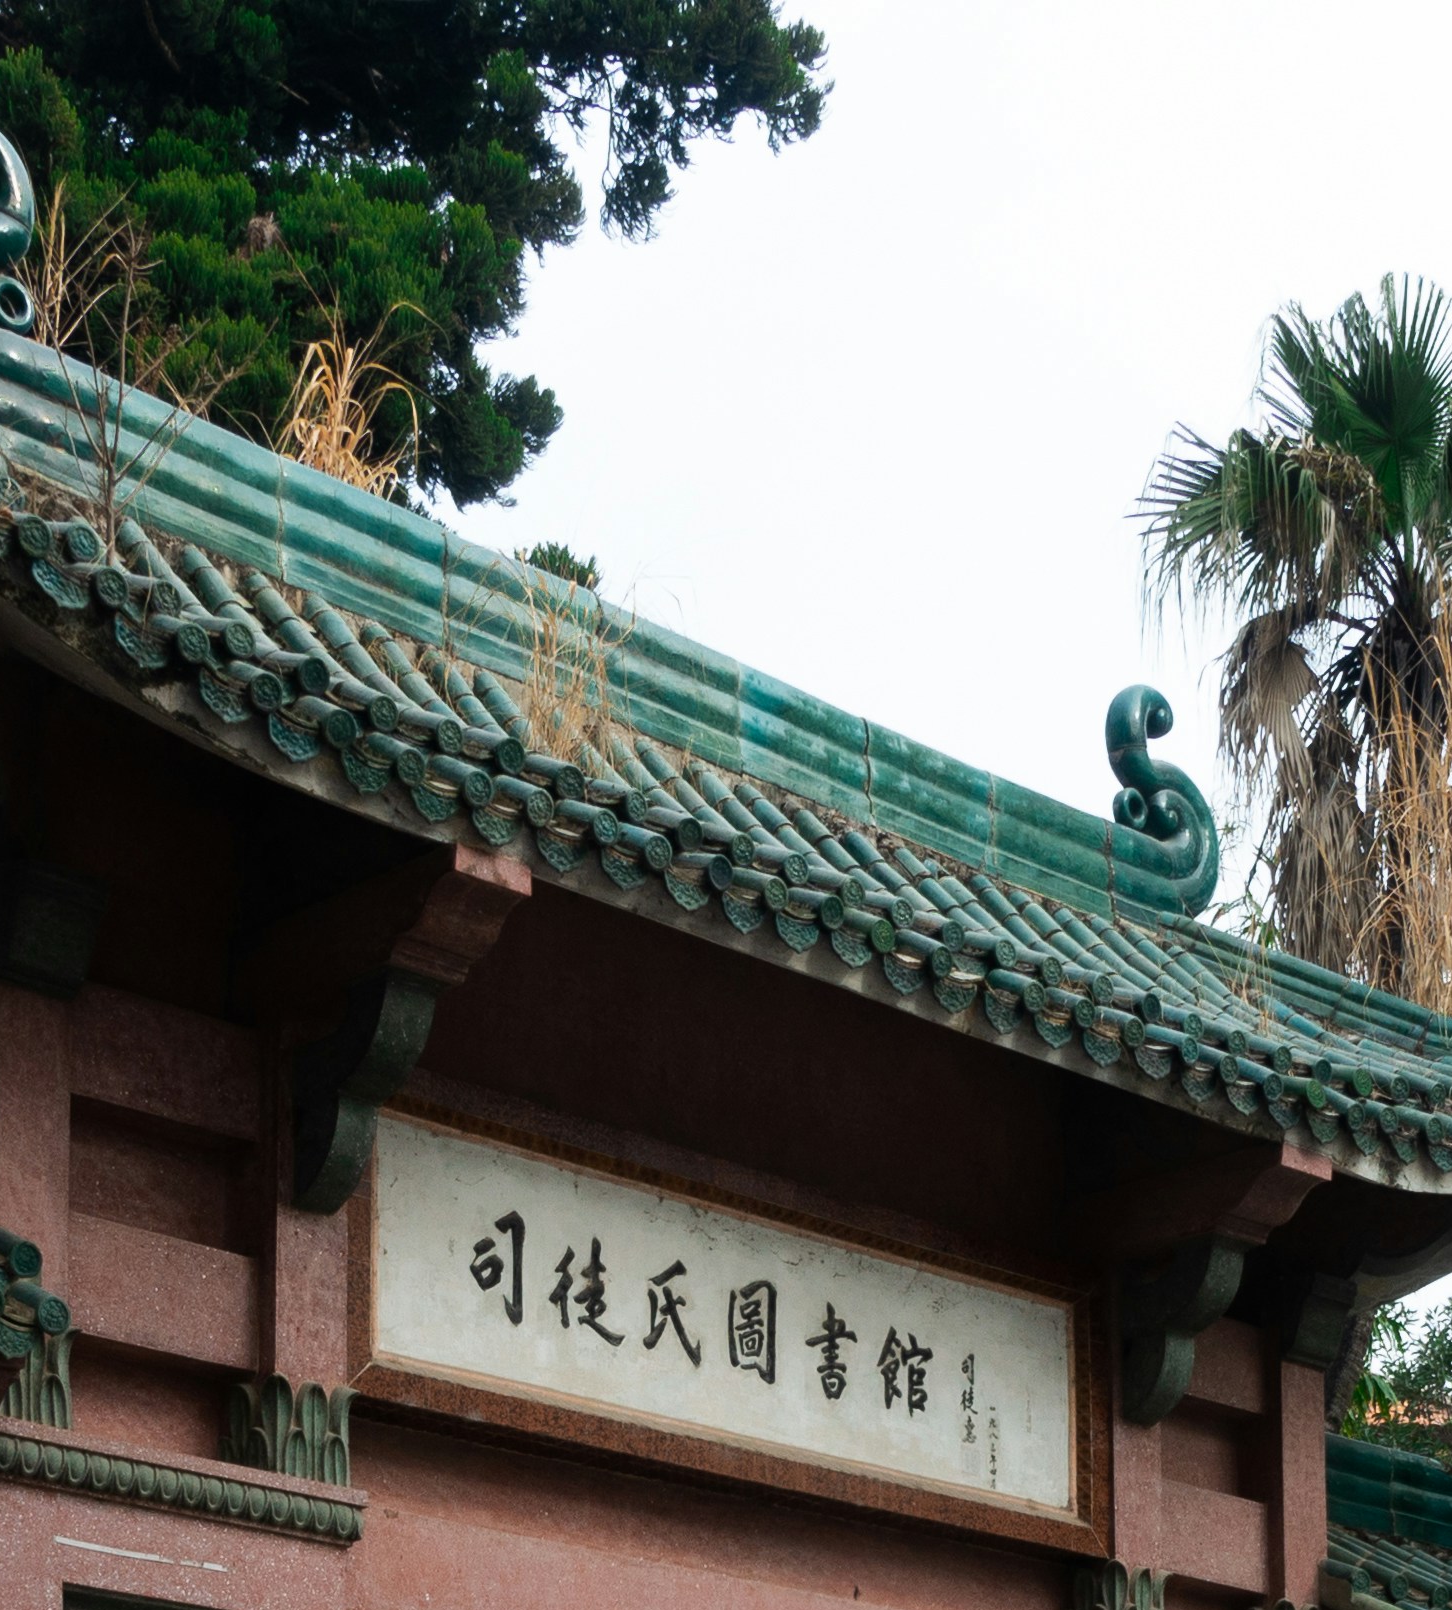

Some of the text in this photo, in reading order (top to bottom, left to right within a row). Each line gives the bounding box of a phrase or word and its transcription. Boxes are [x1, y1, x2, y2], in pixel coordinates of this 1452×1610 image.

[469, 1209, 934, 1418] 司徒氏圖書館
